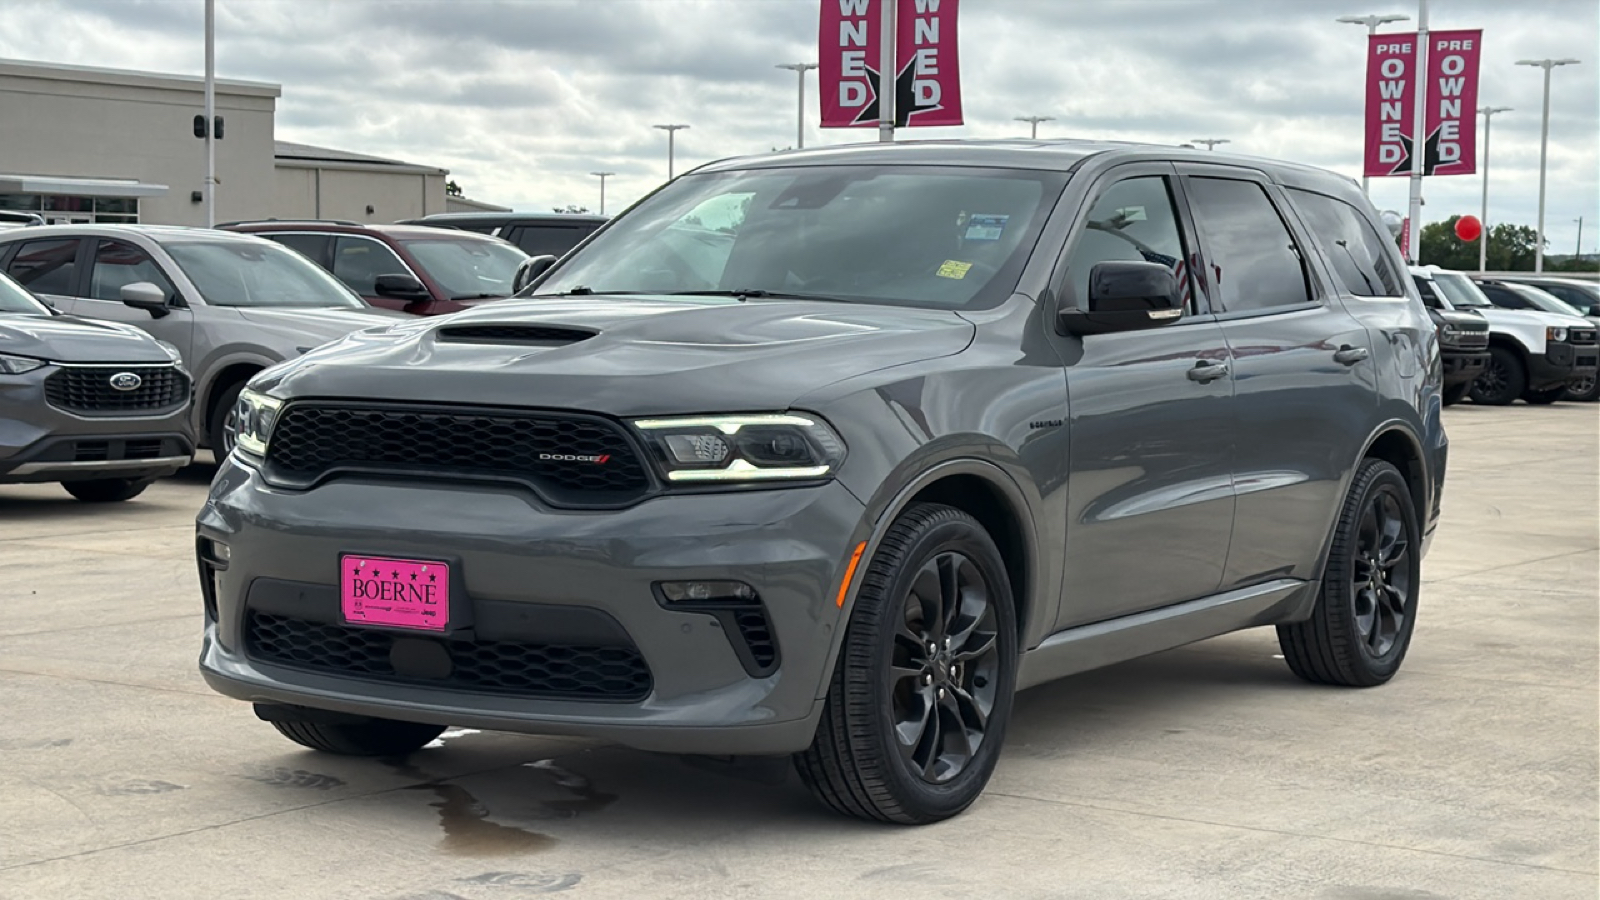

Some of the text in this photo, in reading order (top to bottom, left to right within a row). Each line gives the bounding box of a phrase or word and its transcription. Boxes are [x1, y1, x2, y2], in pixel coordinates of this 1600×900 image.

[1376, 43, 1412, 55] PRE
[1437, 40, 1473, 51] PRE
[1378, 58, 1406, 164] OWNED
[1438, 55, 1466, 162] OWNED
[539, 453, 600, 462] DODGE
[353, 579, 437, 605] BOERNE
